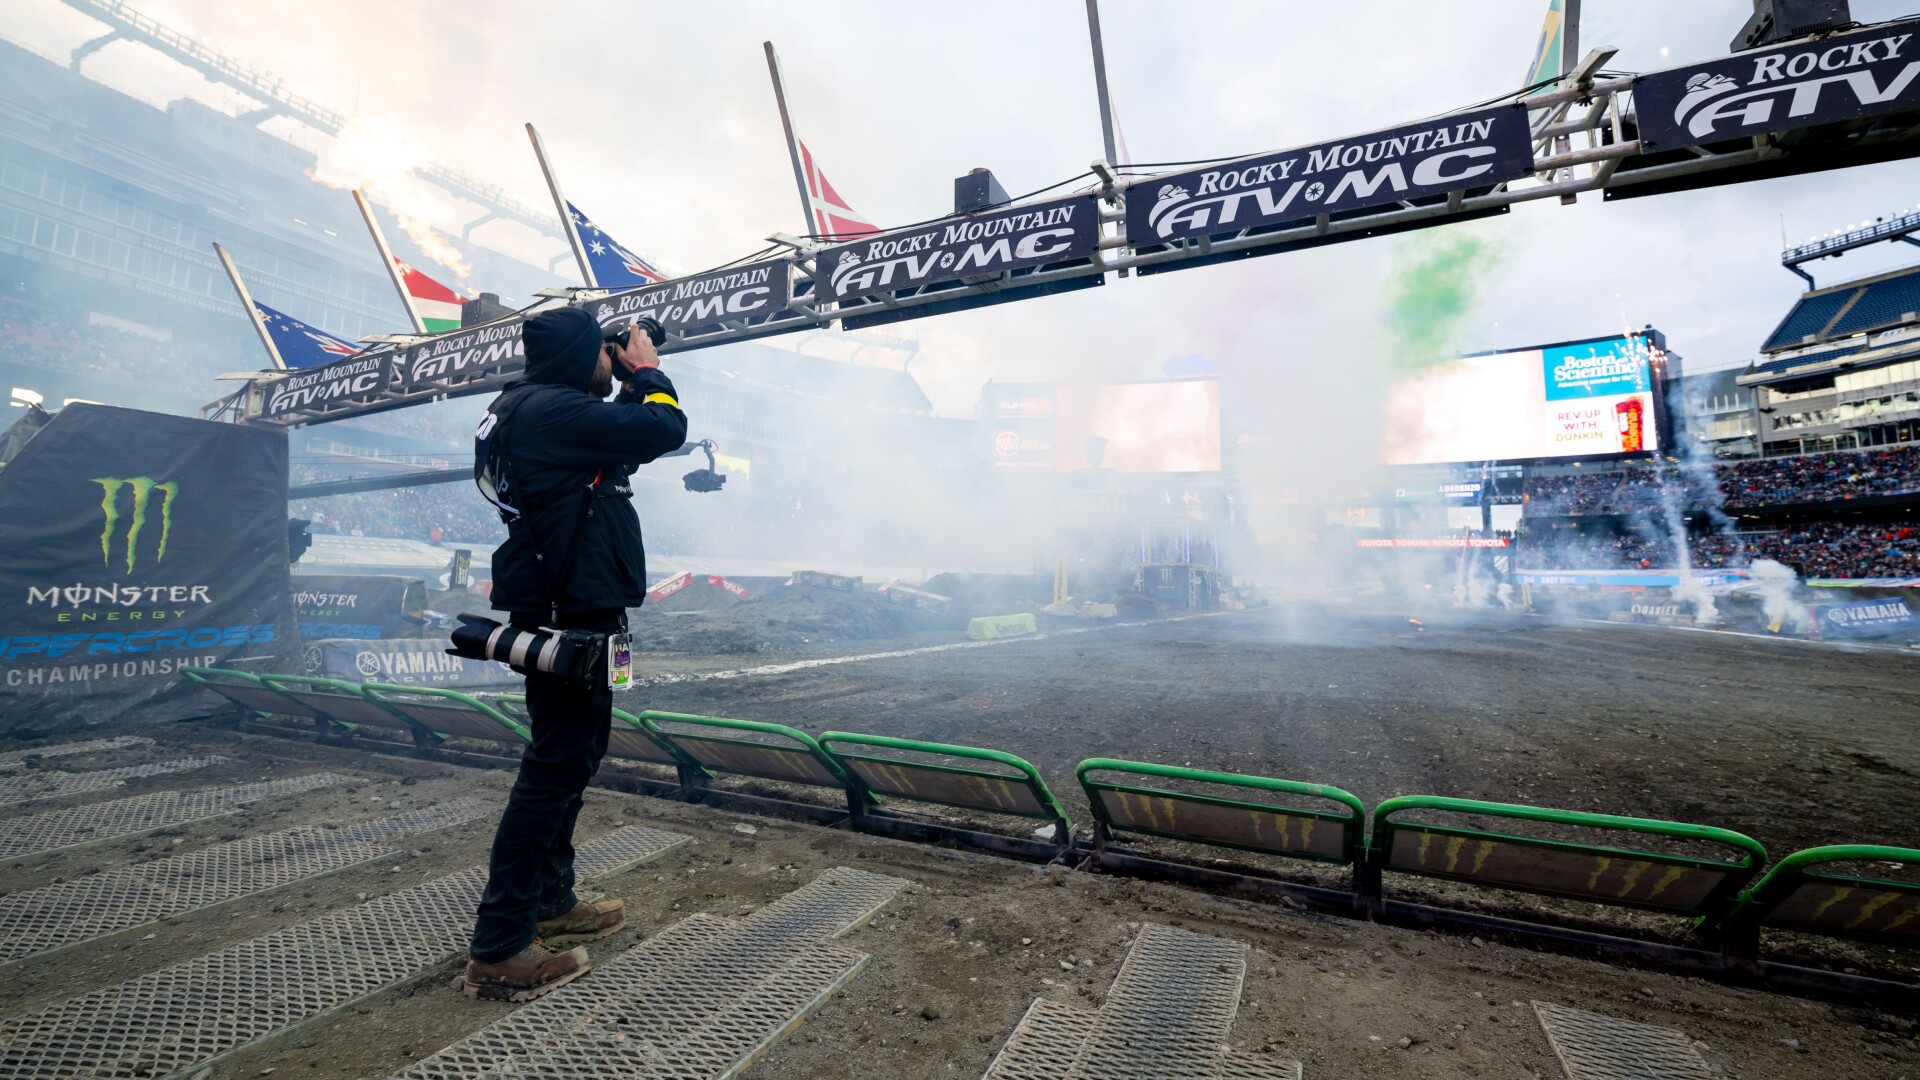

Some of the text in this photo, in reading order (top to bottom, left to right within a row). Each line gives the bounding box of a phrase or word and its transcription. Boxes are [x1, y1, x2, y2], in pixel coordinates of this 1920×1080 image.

[1746, 33, 1913, 86] ROCKY
[1195, 118, 1495, 196] ROCKY MOUNTAIN
[864, 205, 1076, 262] ROCKY MOUNTAIN
[617, 267, 772, 314] ROCKY MOUNTAIN
[434, 322, 523, 355] ROCKY MOUNT
[1554, 357, 1636, 381] Scientific
[1563, 354, 1616, 369] Boston
[286, 357, 382, 392] ROCKY MOUNTAIN
[1558, 409, 1601, 421] REV UP
[1564, 421, 1597, 431] WITH
[1361, 539, 1394, 548] TOYOTA
[1469, 539, 1505, 548] TOYOTA
[27, 582, 213, 608] MONSTER
[57, 610, 186, 622] ENERGY
[1846, 603, 1911, 621] YAMAHA
[7, 655, 216, 686] CHAMPIONSHIP
[380, 651, 464, 674] YAMAHA
[366, 674, 460, 683] RACING
